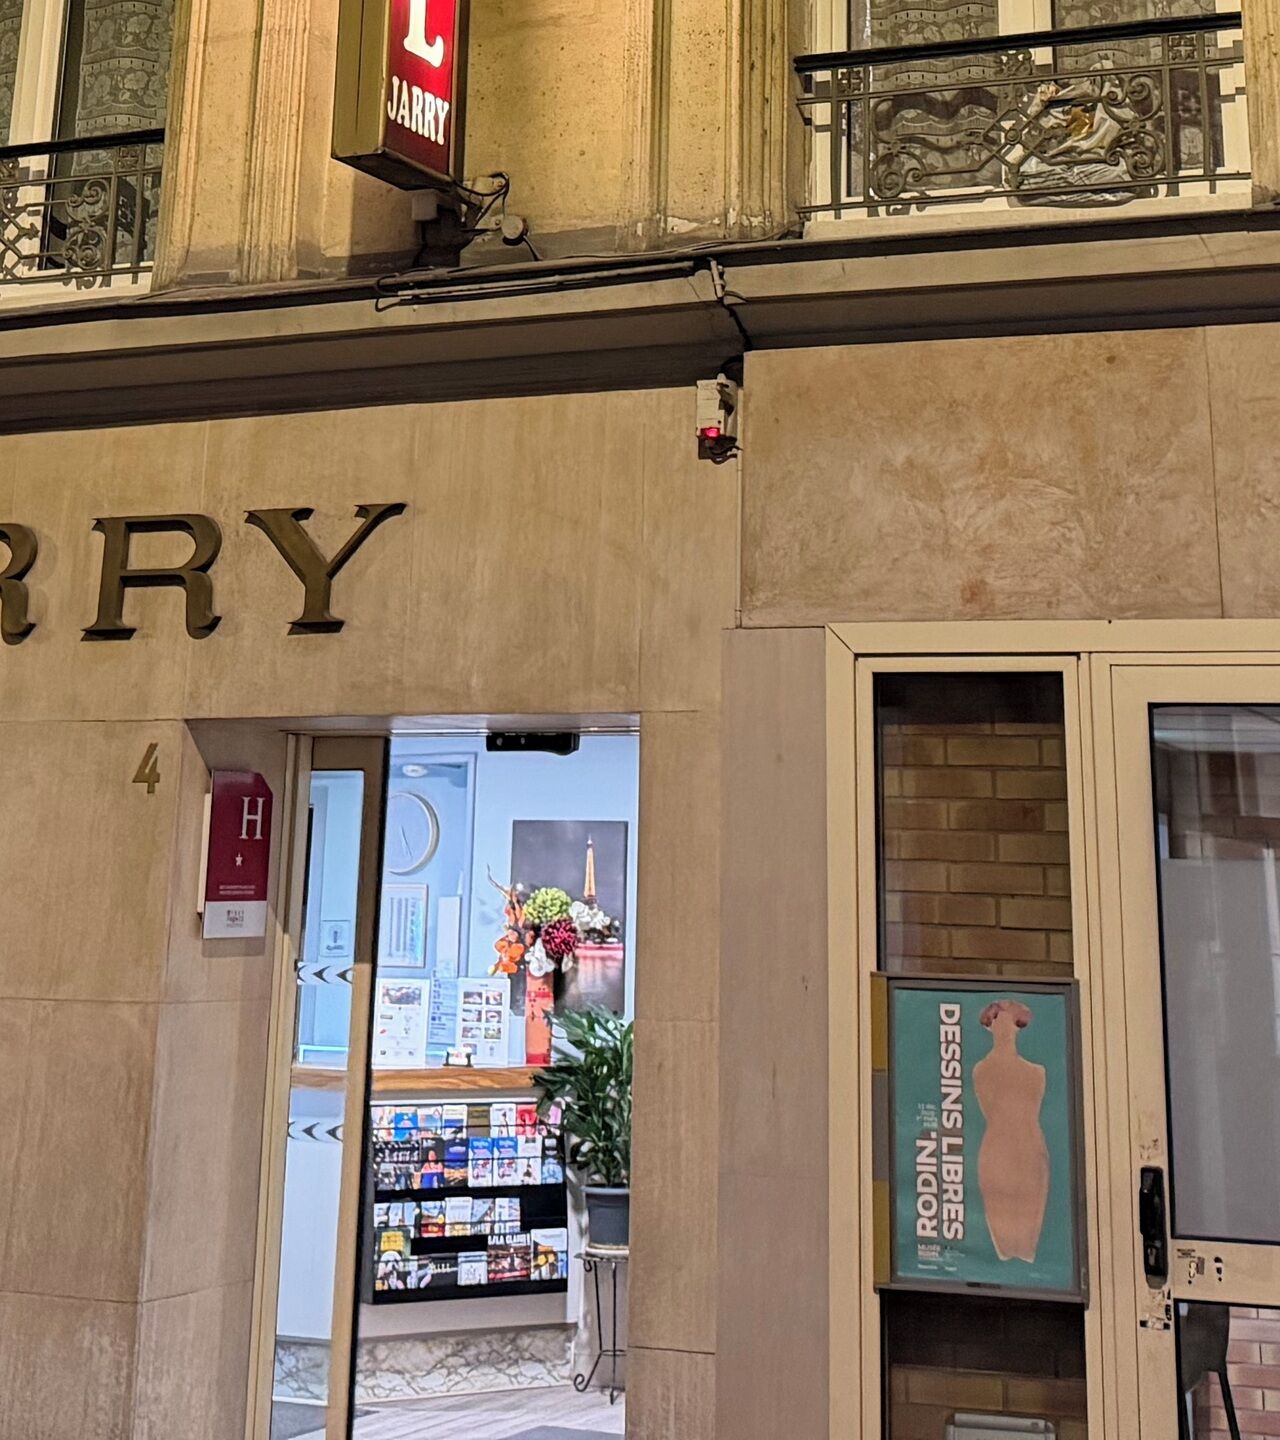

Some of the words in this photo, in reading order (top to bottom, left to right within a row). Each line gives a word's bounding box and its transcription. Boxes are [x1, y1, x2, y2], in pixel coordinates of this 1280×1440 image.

[387, 75, 449, 145] JARRY
[132, 742, 161, 794] 4
[239, 796, 266, 840] H
[939, 1003, 963, 1129] DESSINS
[915, 1131, 938, 1238] RODIN.
[941, 1136, 965, 1241] LIBRES
